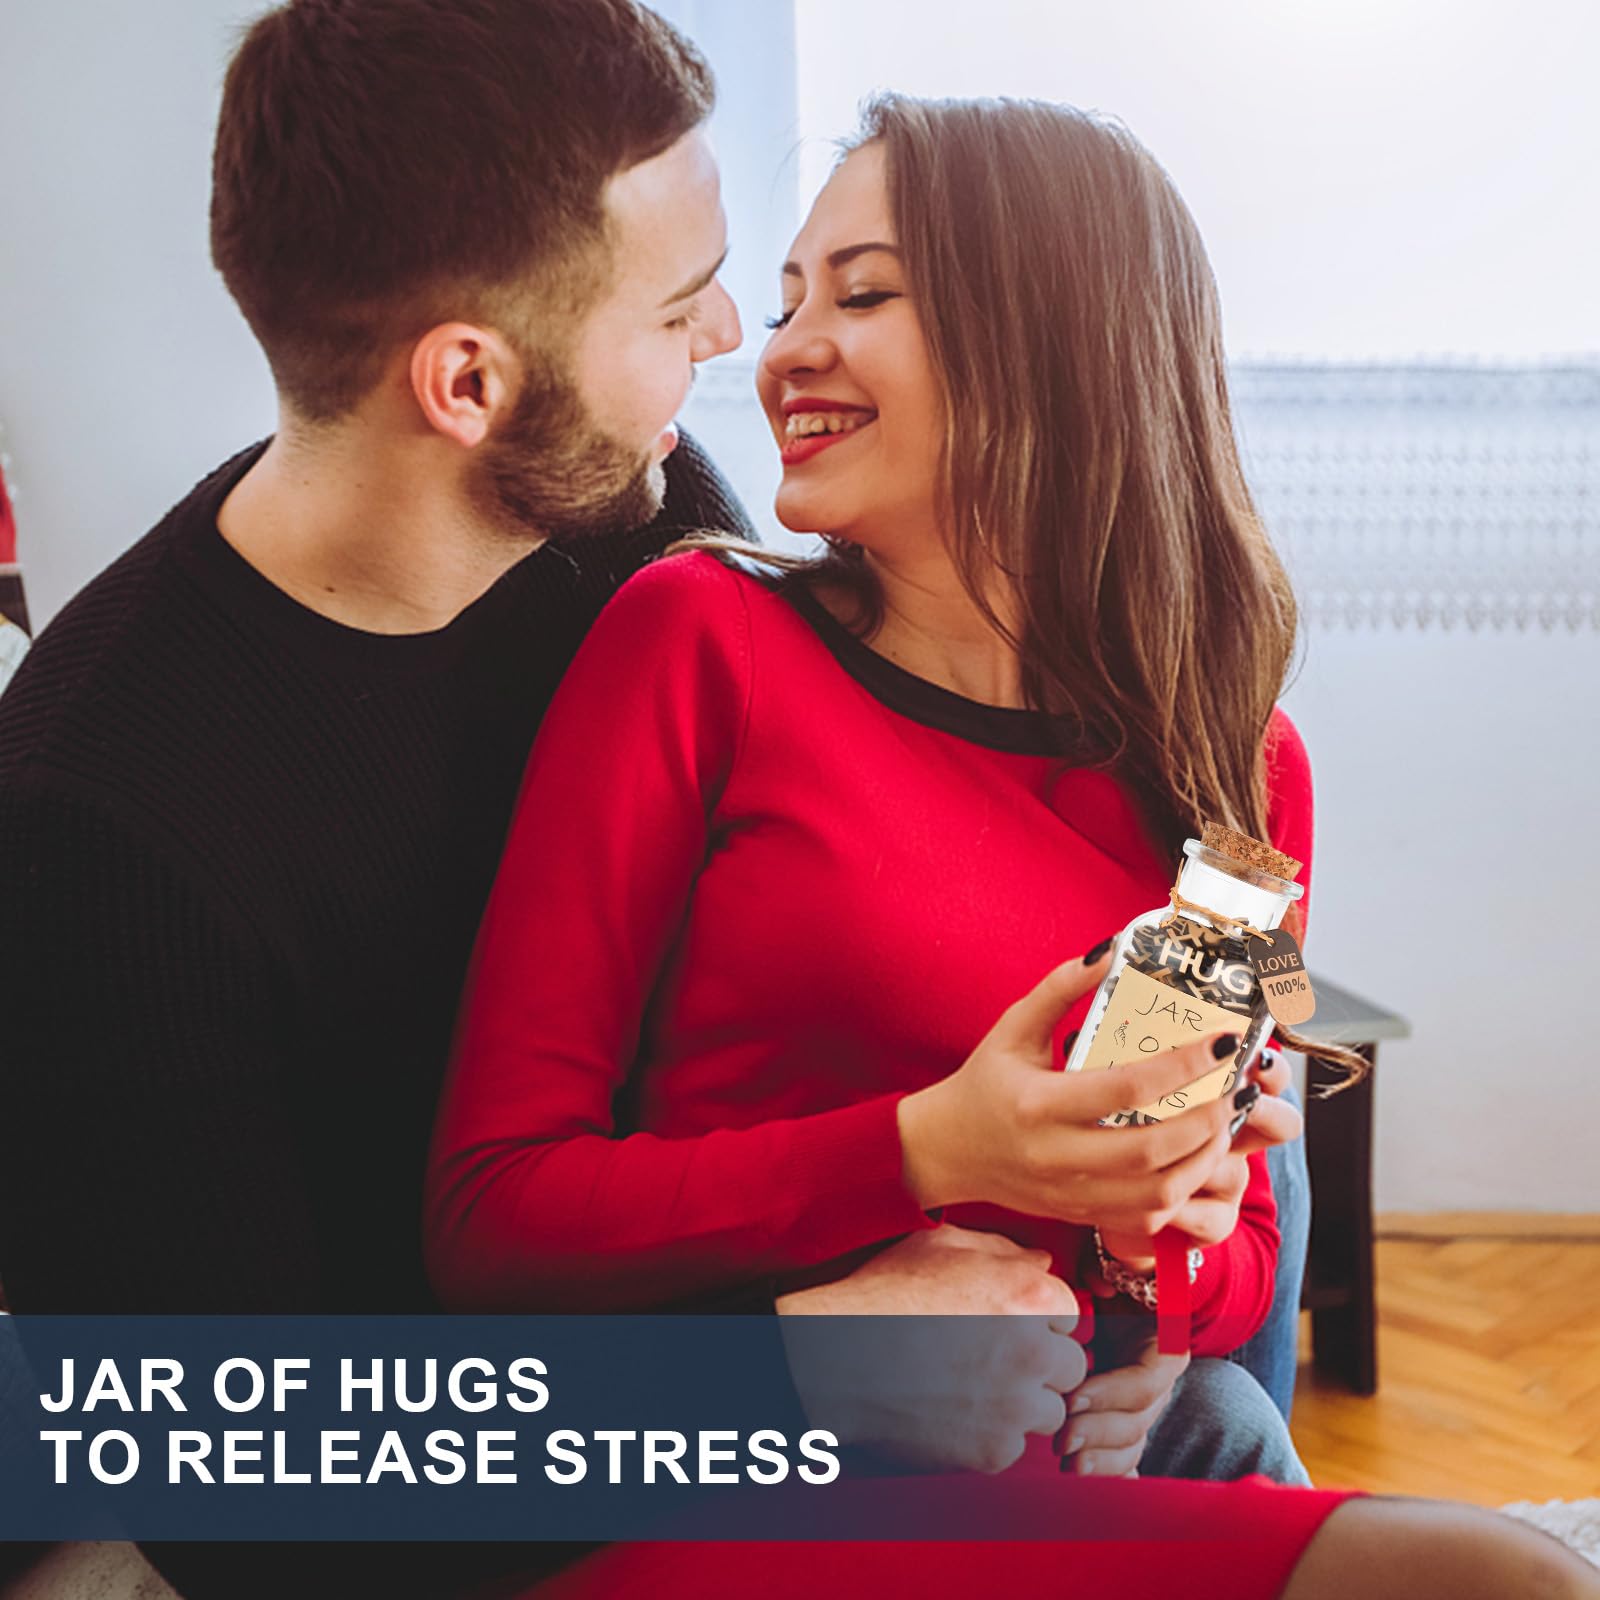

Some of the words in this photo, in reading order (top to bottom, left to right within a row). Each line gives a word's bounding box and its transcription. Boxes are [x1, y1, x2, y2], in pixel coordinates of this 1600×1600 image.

[1158, 938, 1253, 996] HUG
[1258, 952, 1300, 974] LOVE
[1267, 976, 1306, 998] 100%
[1134, 993, 1203, 1032] JAR
